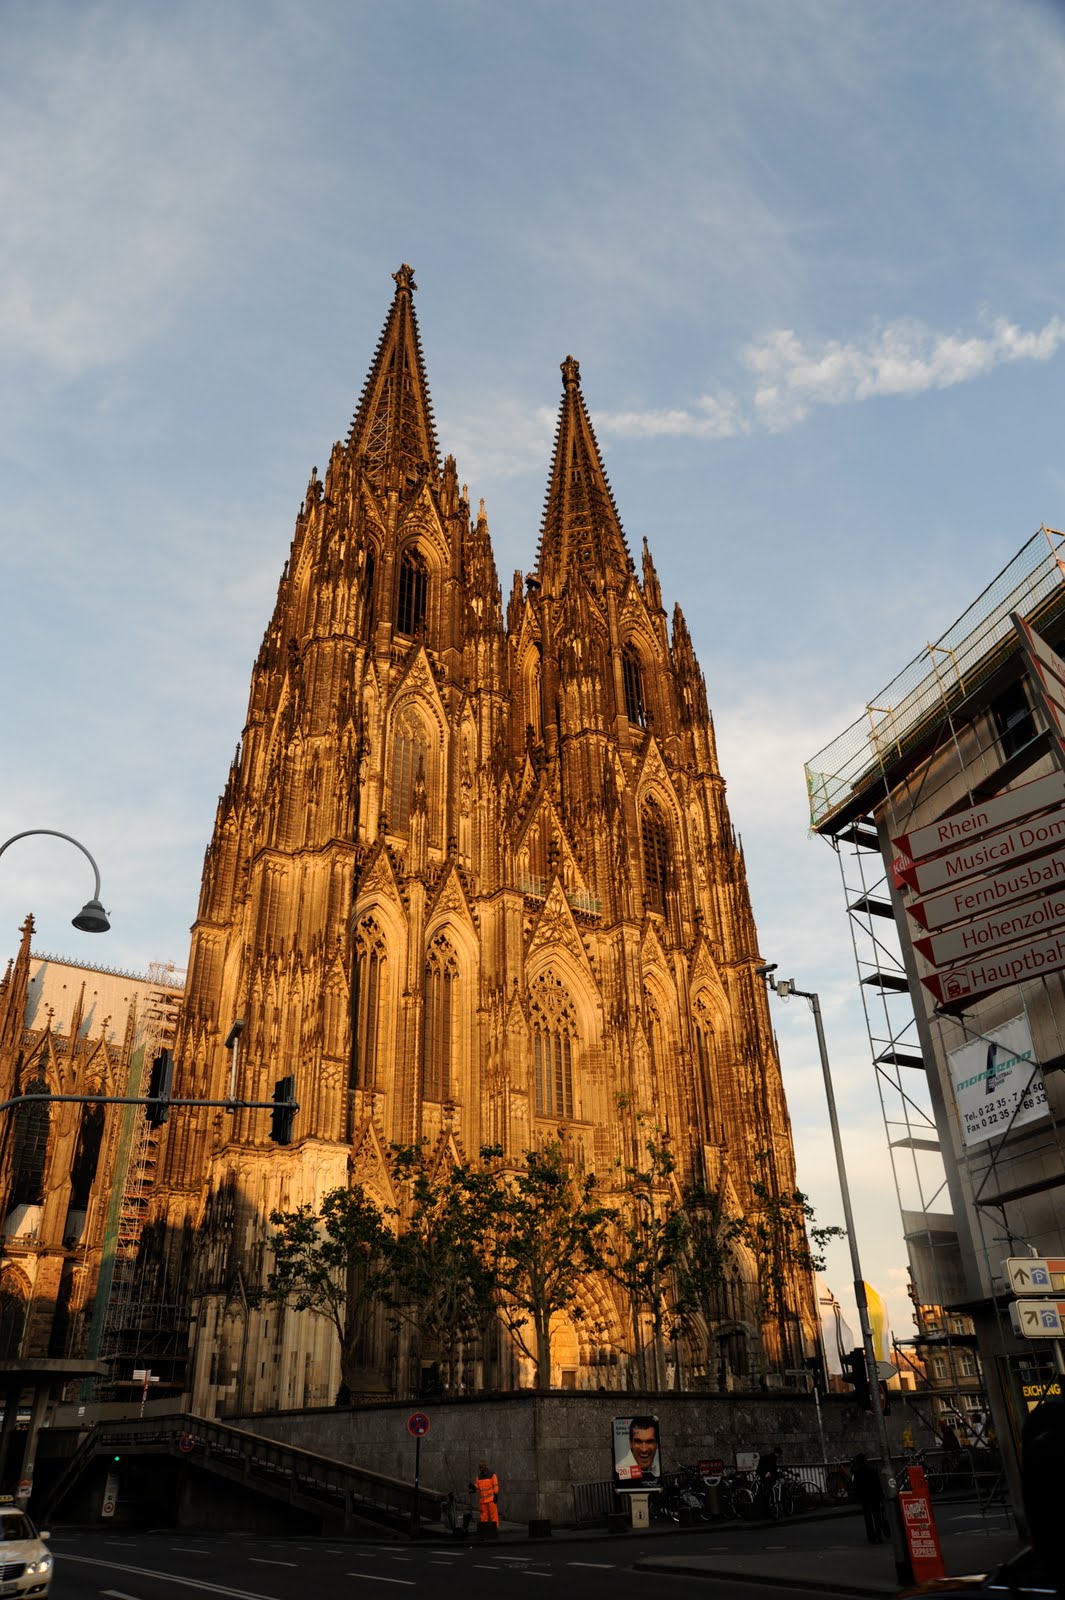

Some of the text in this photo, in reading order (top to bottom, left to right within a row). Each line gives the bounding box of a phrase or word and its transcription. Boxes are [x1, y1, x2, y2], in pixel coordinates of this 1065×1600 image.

[938, 813, 989, 843] Rhein
[945, 835, 1015, 878] Musical
[964, 1111, 978, 1122] Tel.
[978, 1107, 984, 1116] 0
[985, 1103, 995, 1114] 22
[997, 1098, 1007, 1109] 35
[1012, 1092, 1018, 1102] 7
[1033, 1082, 1044, 1094] 50
[967, 1123, 980, 1134] Fax
[981, 1118, 987, 1127] 0
[988, 1114, 998, 1125] 22
[1000, 1108, 1010, 1120] 35
[1023, 1099, 1034, 1110] 68
[1036, 1093, 1047, 1105] 33
